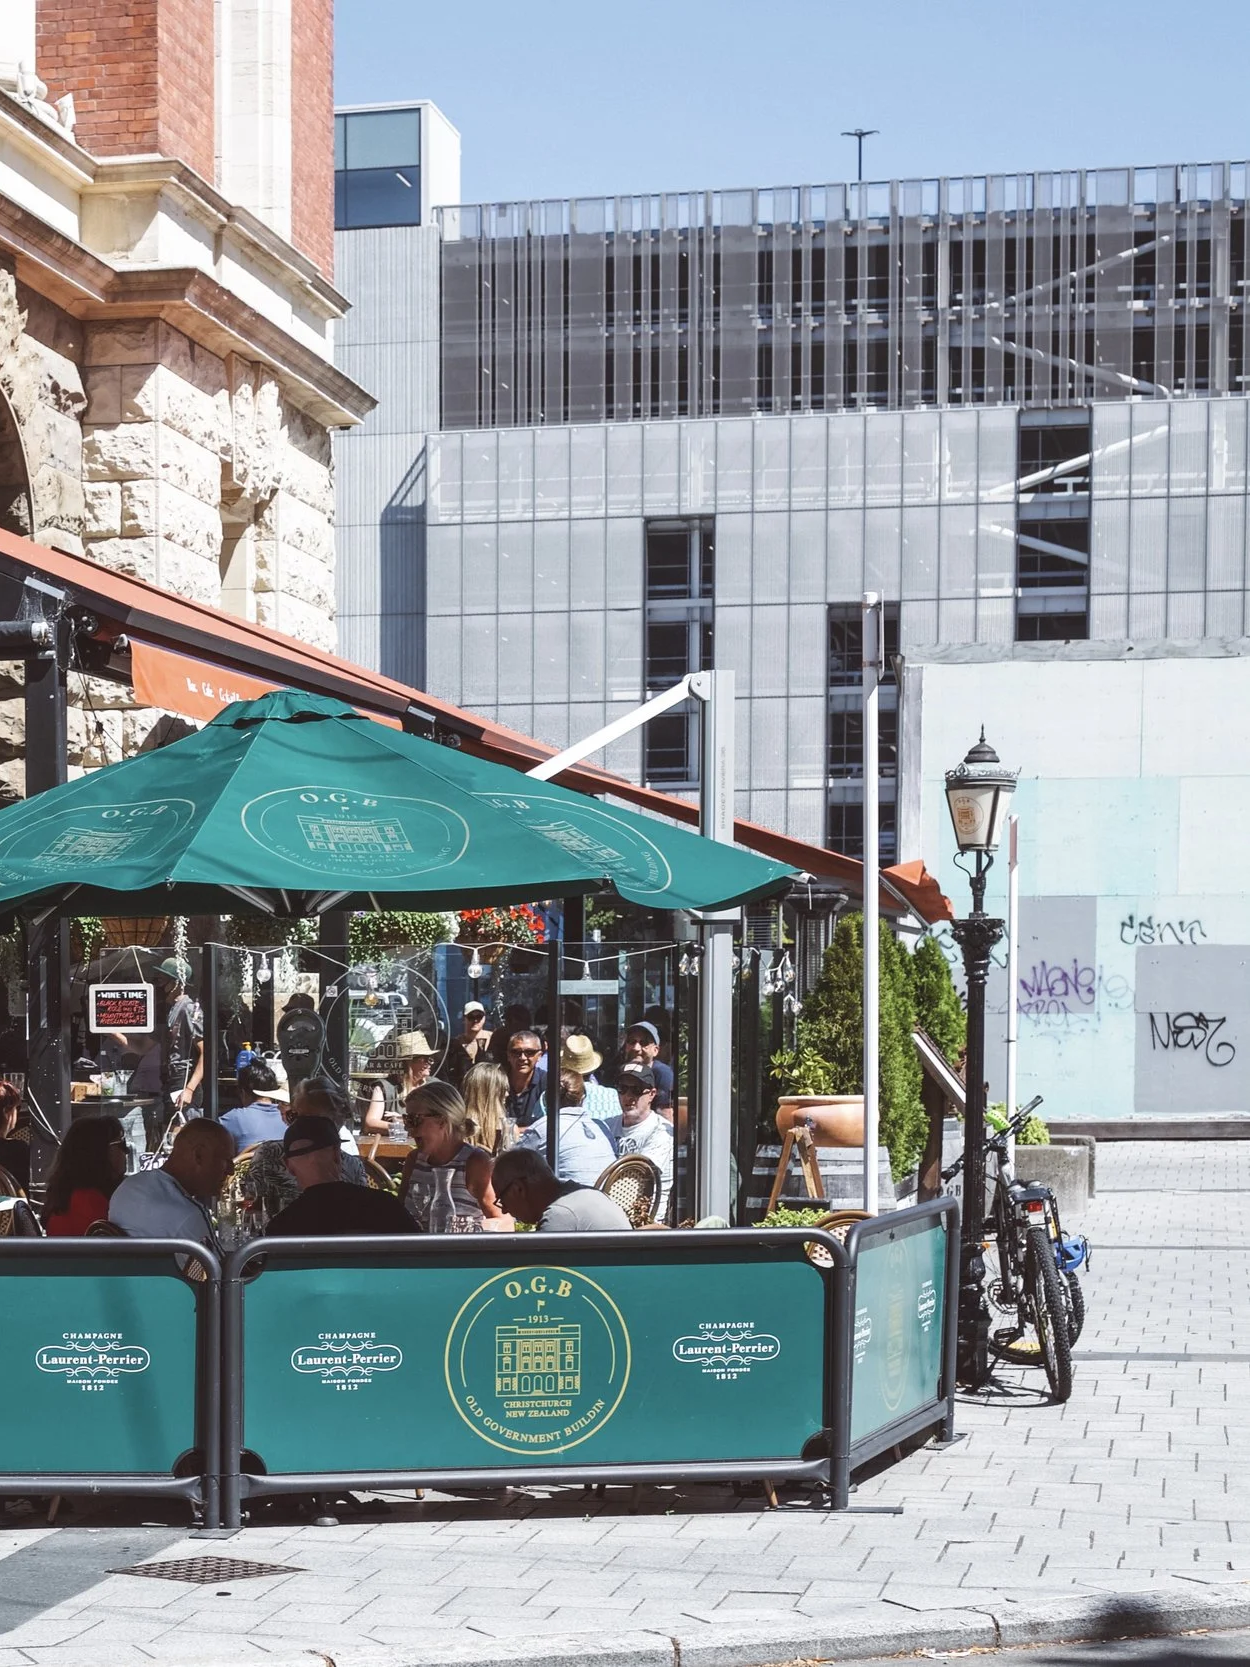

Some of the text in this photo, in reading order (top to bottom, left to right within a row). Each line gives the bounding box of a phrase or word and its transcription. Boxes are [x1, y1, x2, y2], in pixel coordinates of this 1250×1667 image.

[299, 792, 379, 808] O.G.B
[101, 991, 144, 999] WINE TIME
[504, 1275, 573, 1299] O.G.B
[528, 1315, 549, 1324] 1913
[698, 1322, 755, 1330] CHAMPAGNE
[318, 1332, 376, 1340] CHAMPAGNE
[678, 1342, 775, 1355] Laurent-Perrier
[42, 1353, 144, 1365] Laurent-Perrier
[297, 1353, 397, 1366] Laurent-Perrier
[503, 1399, 572, 1409] CHRISTCHURCH
[505, 1408, 570, 1418] NEW ZEALAND
[465, 1395, 606, 1443] OLD GOVERNMENT BUILDIN
